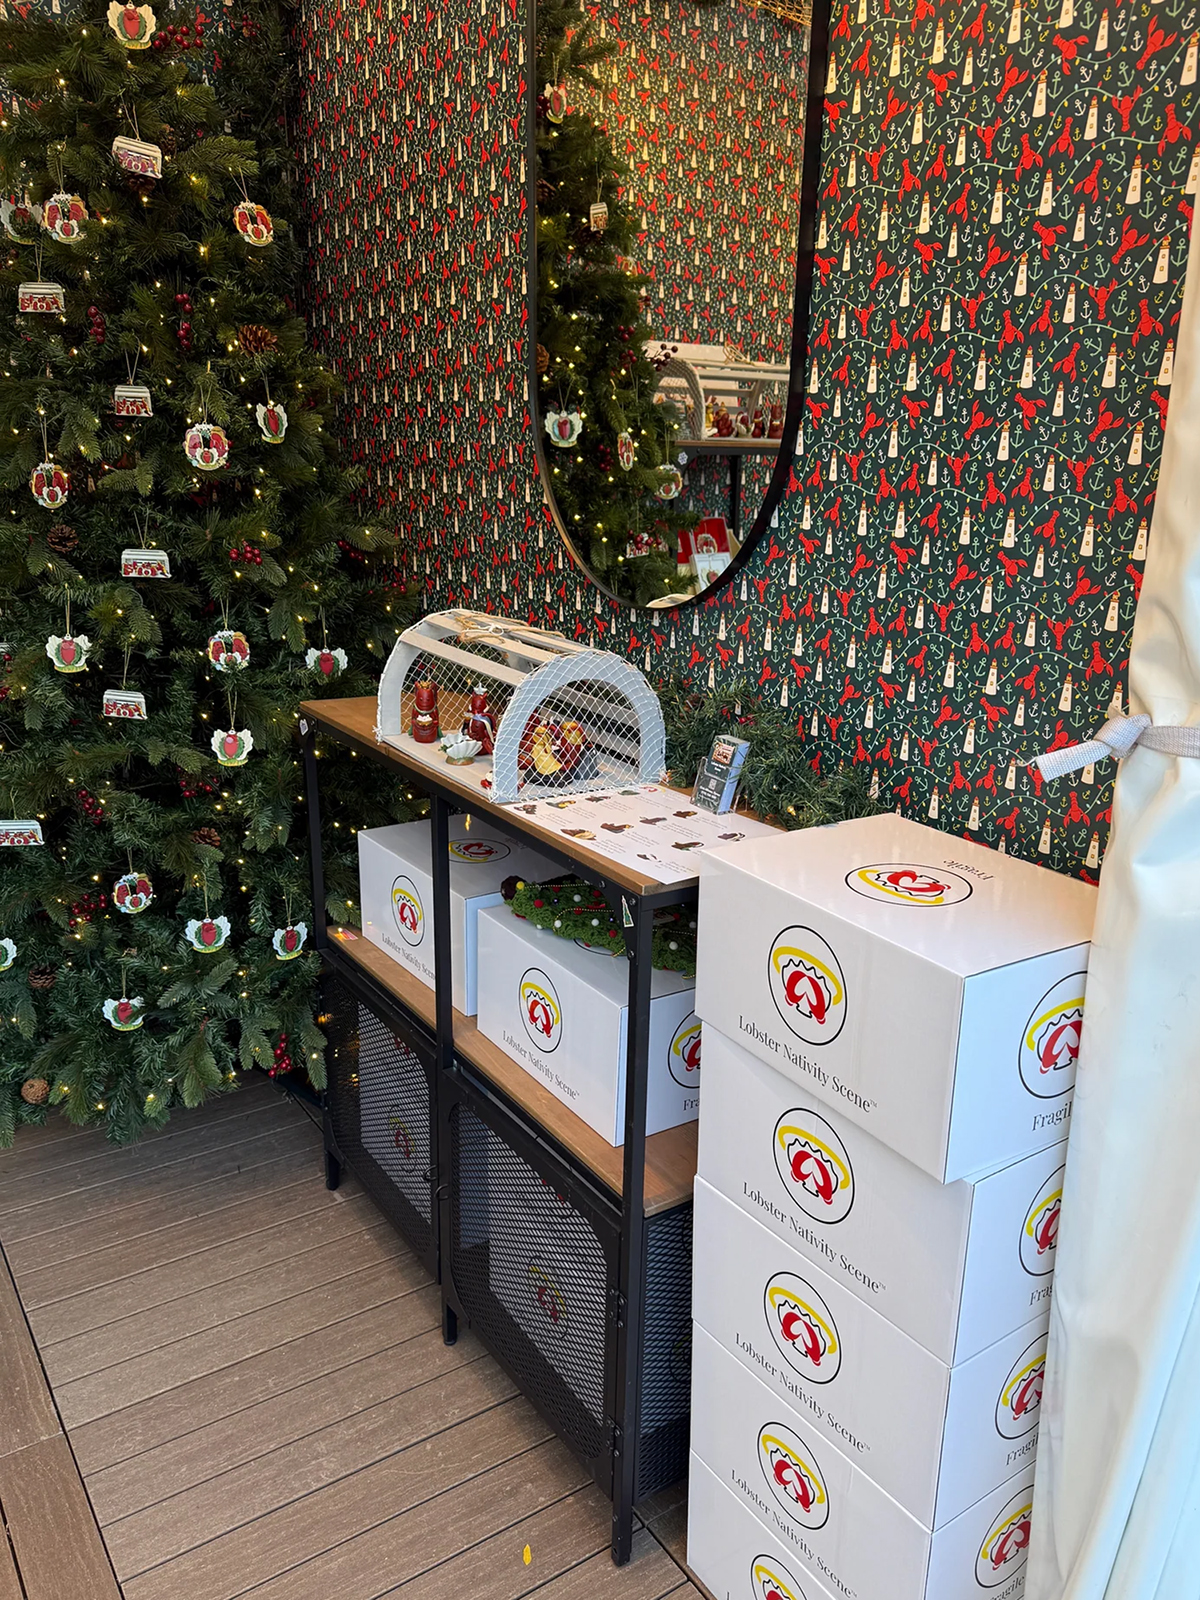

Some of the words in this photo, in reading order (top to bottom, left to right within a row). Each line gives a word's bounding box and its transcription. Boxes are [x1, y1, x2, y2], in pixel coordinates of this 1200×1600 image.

[943, 859, 994, 881] Fragile
[381, 932, 401, 954] Lobster
[401, 947, 421, 971] Nativity
[421, 963, 436, 981] Scen
[502, 1030, 528, 1058] Lobster
[528, 1051, 554, 1082] Nativity
[739, 1015, 781, 1054] Lobster
[783, 1043, 830, 1087] Nativity
[1032, 1100, 1072, 1132] Fragil
[743, 1181, 787, 1224] Lobster
[789, 1216, 837, 1263] Nativity
[735, 1332, 778, 1377] Lobster
[780, 1371, 825, 1419] Nativity
[1005, 1432, 1039, 1467] Fragil
[731, 1469, 771, 1515] Lobster
[772, 1510, 815, 1560] Nativity
